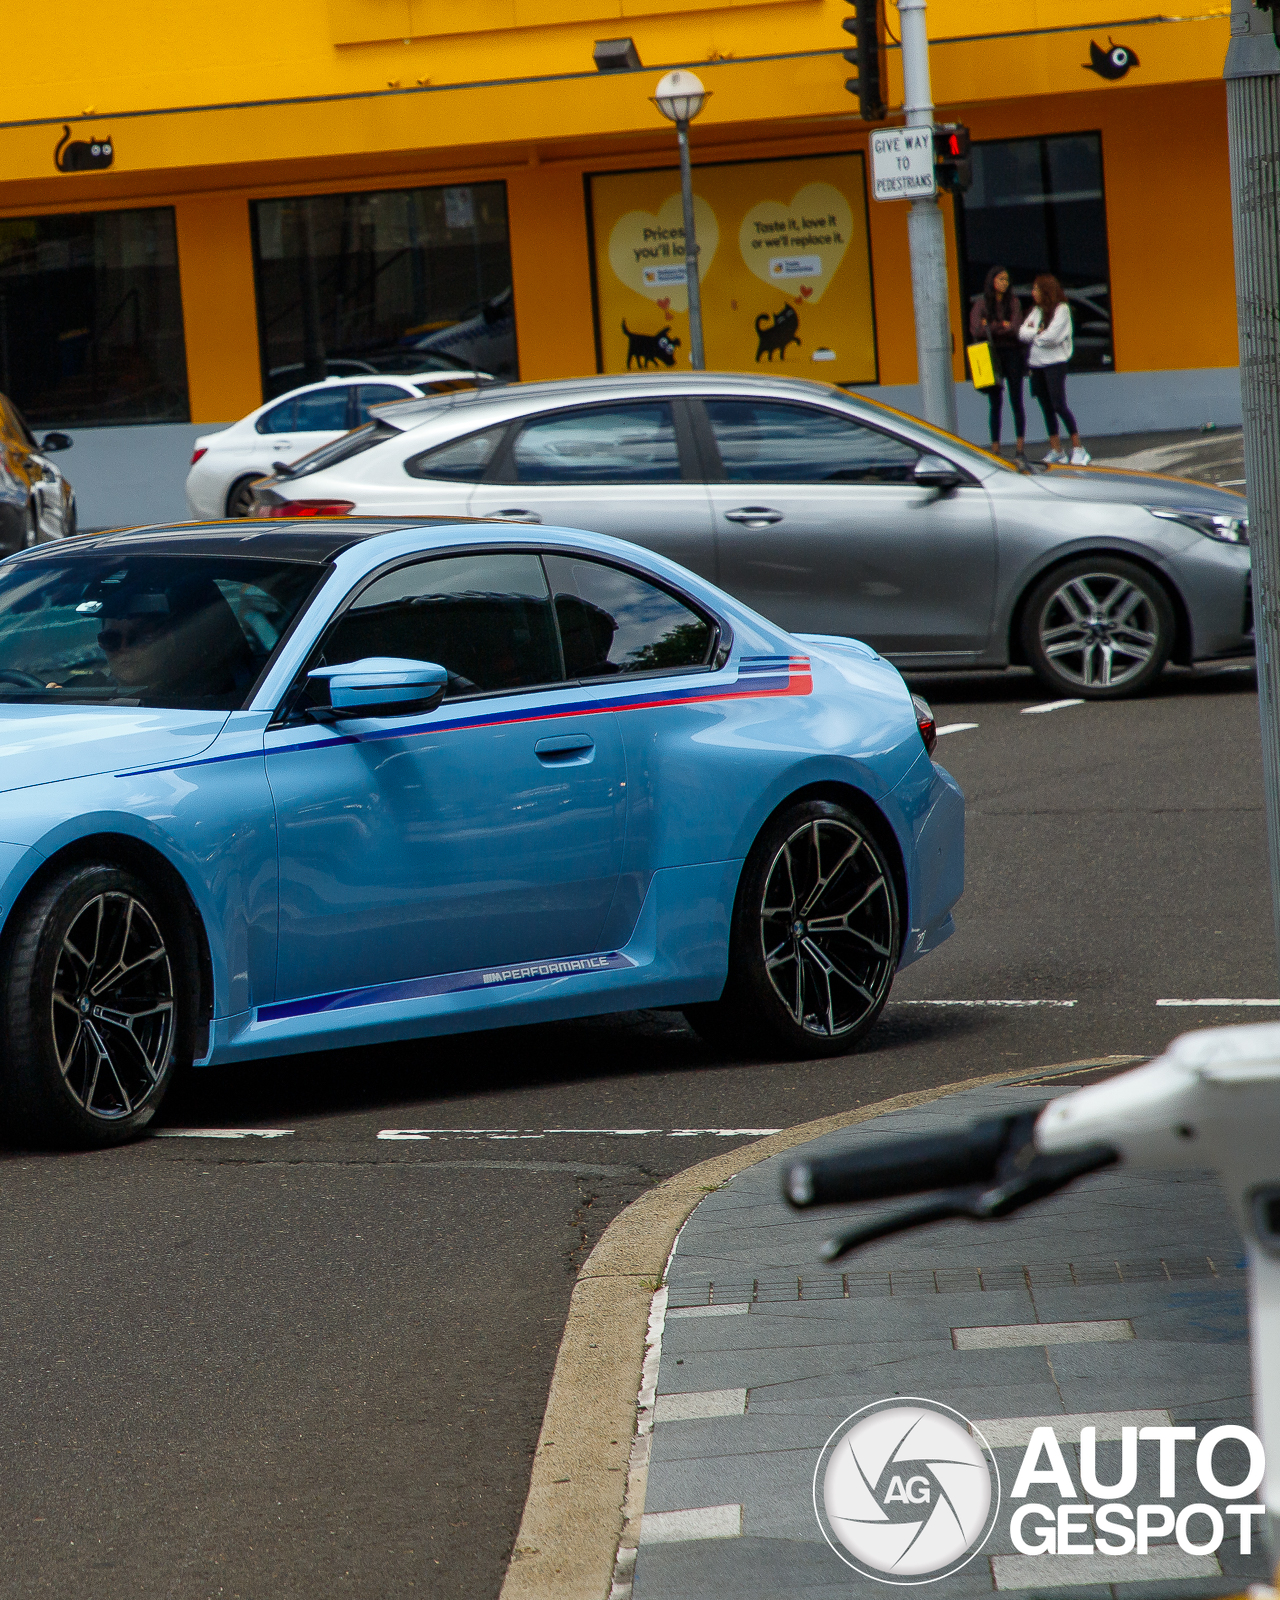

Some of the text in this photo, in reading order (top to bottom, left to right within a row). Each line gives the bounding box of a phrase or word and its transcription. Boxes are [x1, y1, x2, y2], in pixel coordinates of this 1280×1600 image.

[875, 134, 929, 154] GIVE WAY
[896, 155, 910, 171] TO
[876, 173, 933, 192] PEDESTRIANS
[753, 213, 838, 233] Taste it, love it
[751, 239, 762, 249] or
[765, 234, 789, 247] we'll
[790, 233, 832, 249] replace
[633, 241, 701, 263] you'll loe
[502, 956, 610, 982] PERFORMANCE
